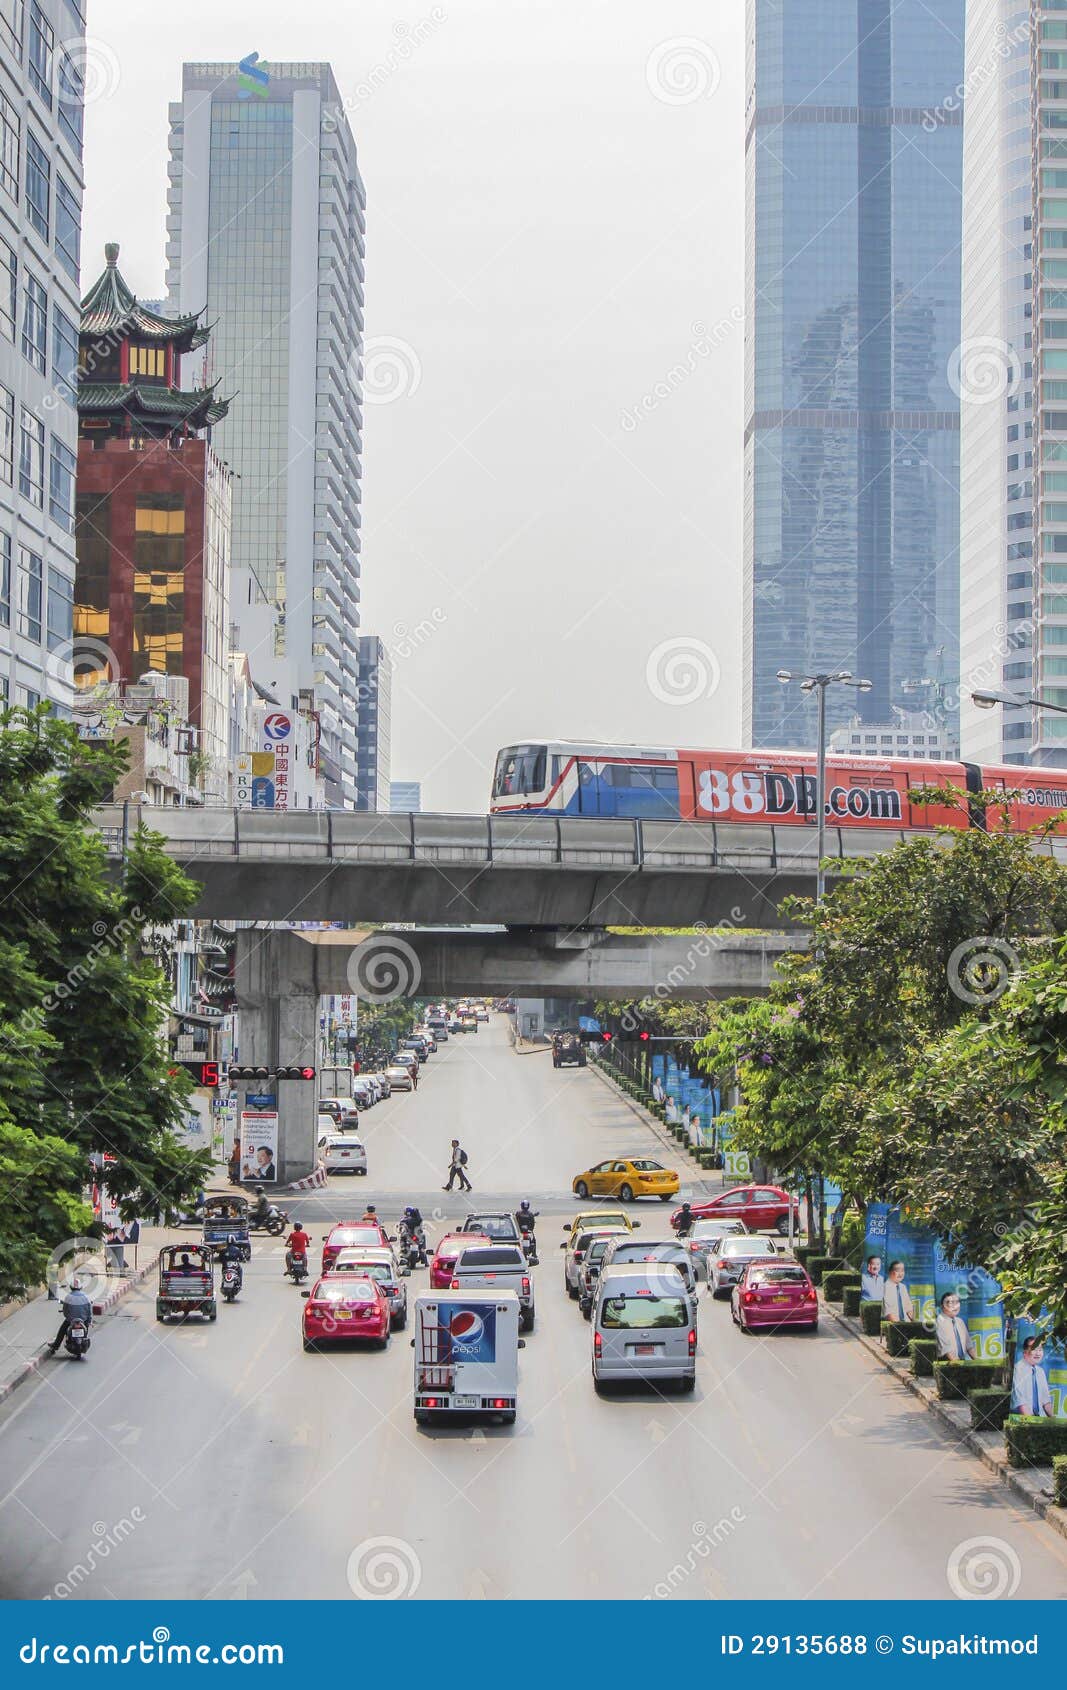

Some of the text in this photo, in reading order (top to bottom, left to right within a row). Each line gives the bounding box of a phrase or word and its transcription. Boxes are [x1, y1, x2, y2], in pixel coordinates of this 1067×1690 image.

[698, 769, 903, 819] 88DB.com
[201, 1063, 218, 1086] 15
[726, 1155, 748, 1174] 16
[912, 1299, 936, 1320] 16
[452, 1345, 481, 1354] pepsi
[970, 1332, 1003, 1358] 16
